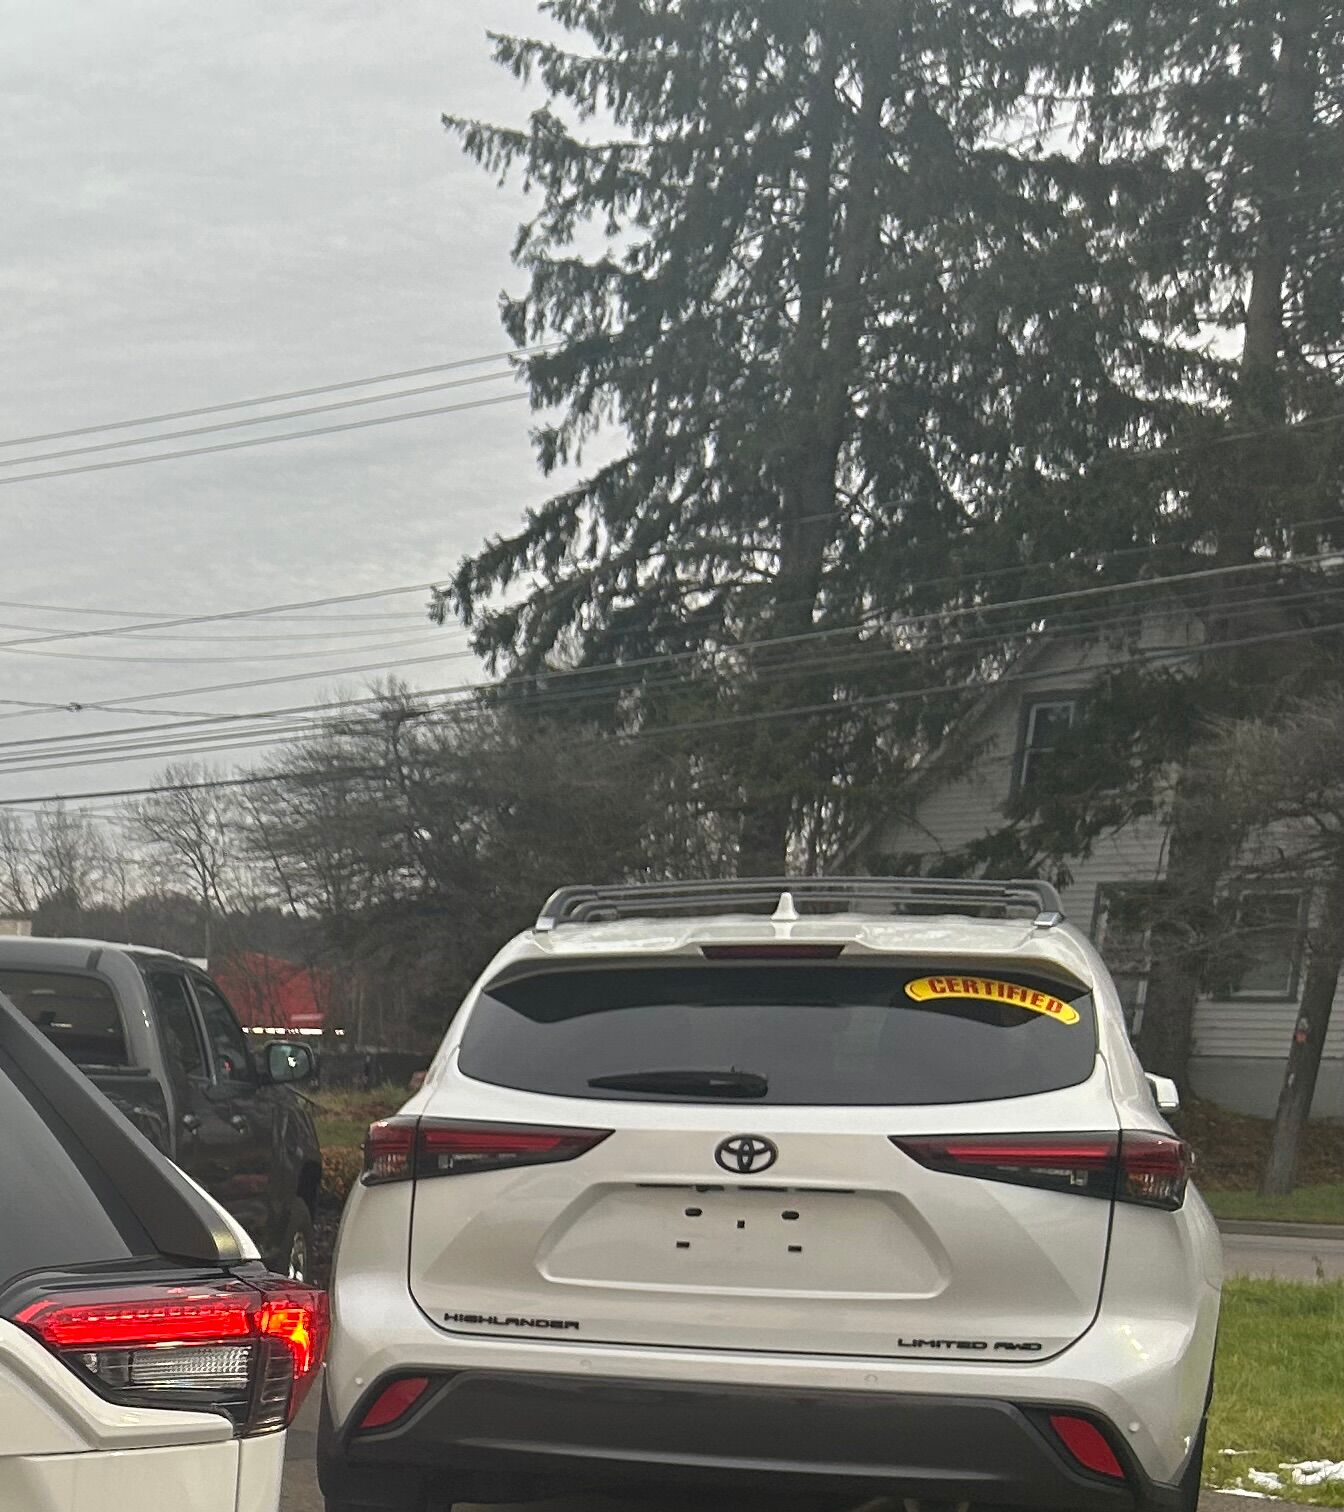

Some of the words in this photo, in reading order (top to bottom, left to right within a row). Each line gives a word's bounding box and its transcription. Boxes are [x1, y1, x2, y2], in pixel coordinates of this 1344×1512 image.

[928, 977, 1064, 1014] CERTIFIED
[444, 1312, 580, 1330] HIGHLANDER
[897, 1338, 988, 1350] LIMITED
[993, 1341, 1042, 1351] AWD
